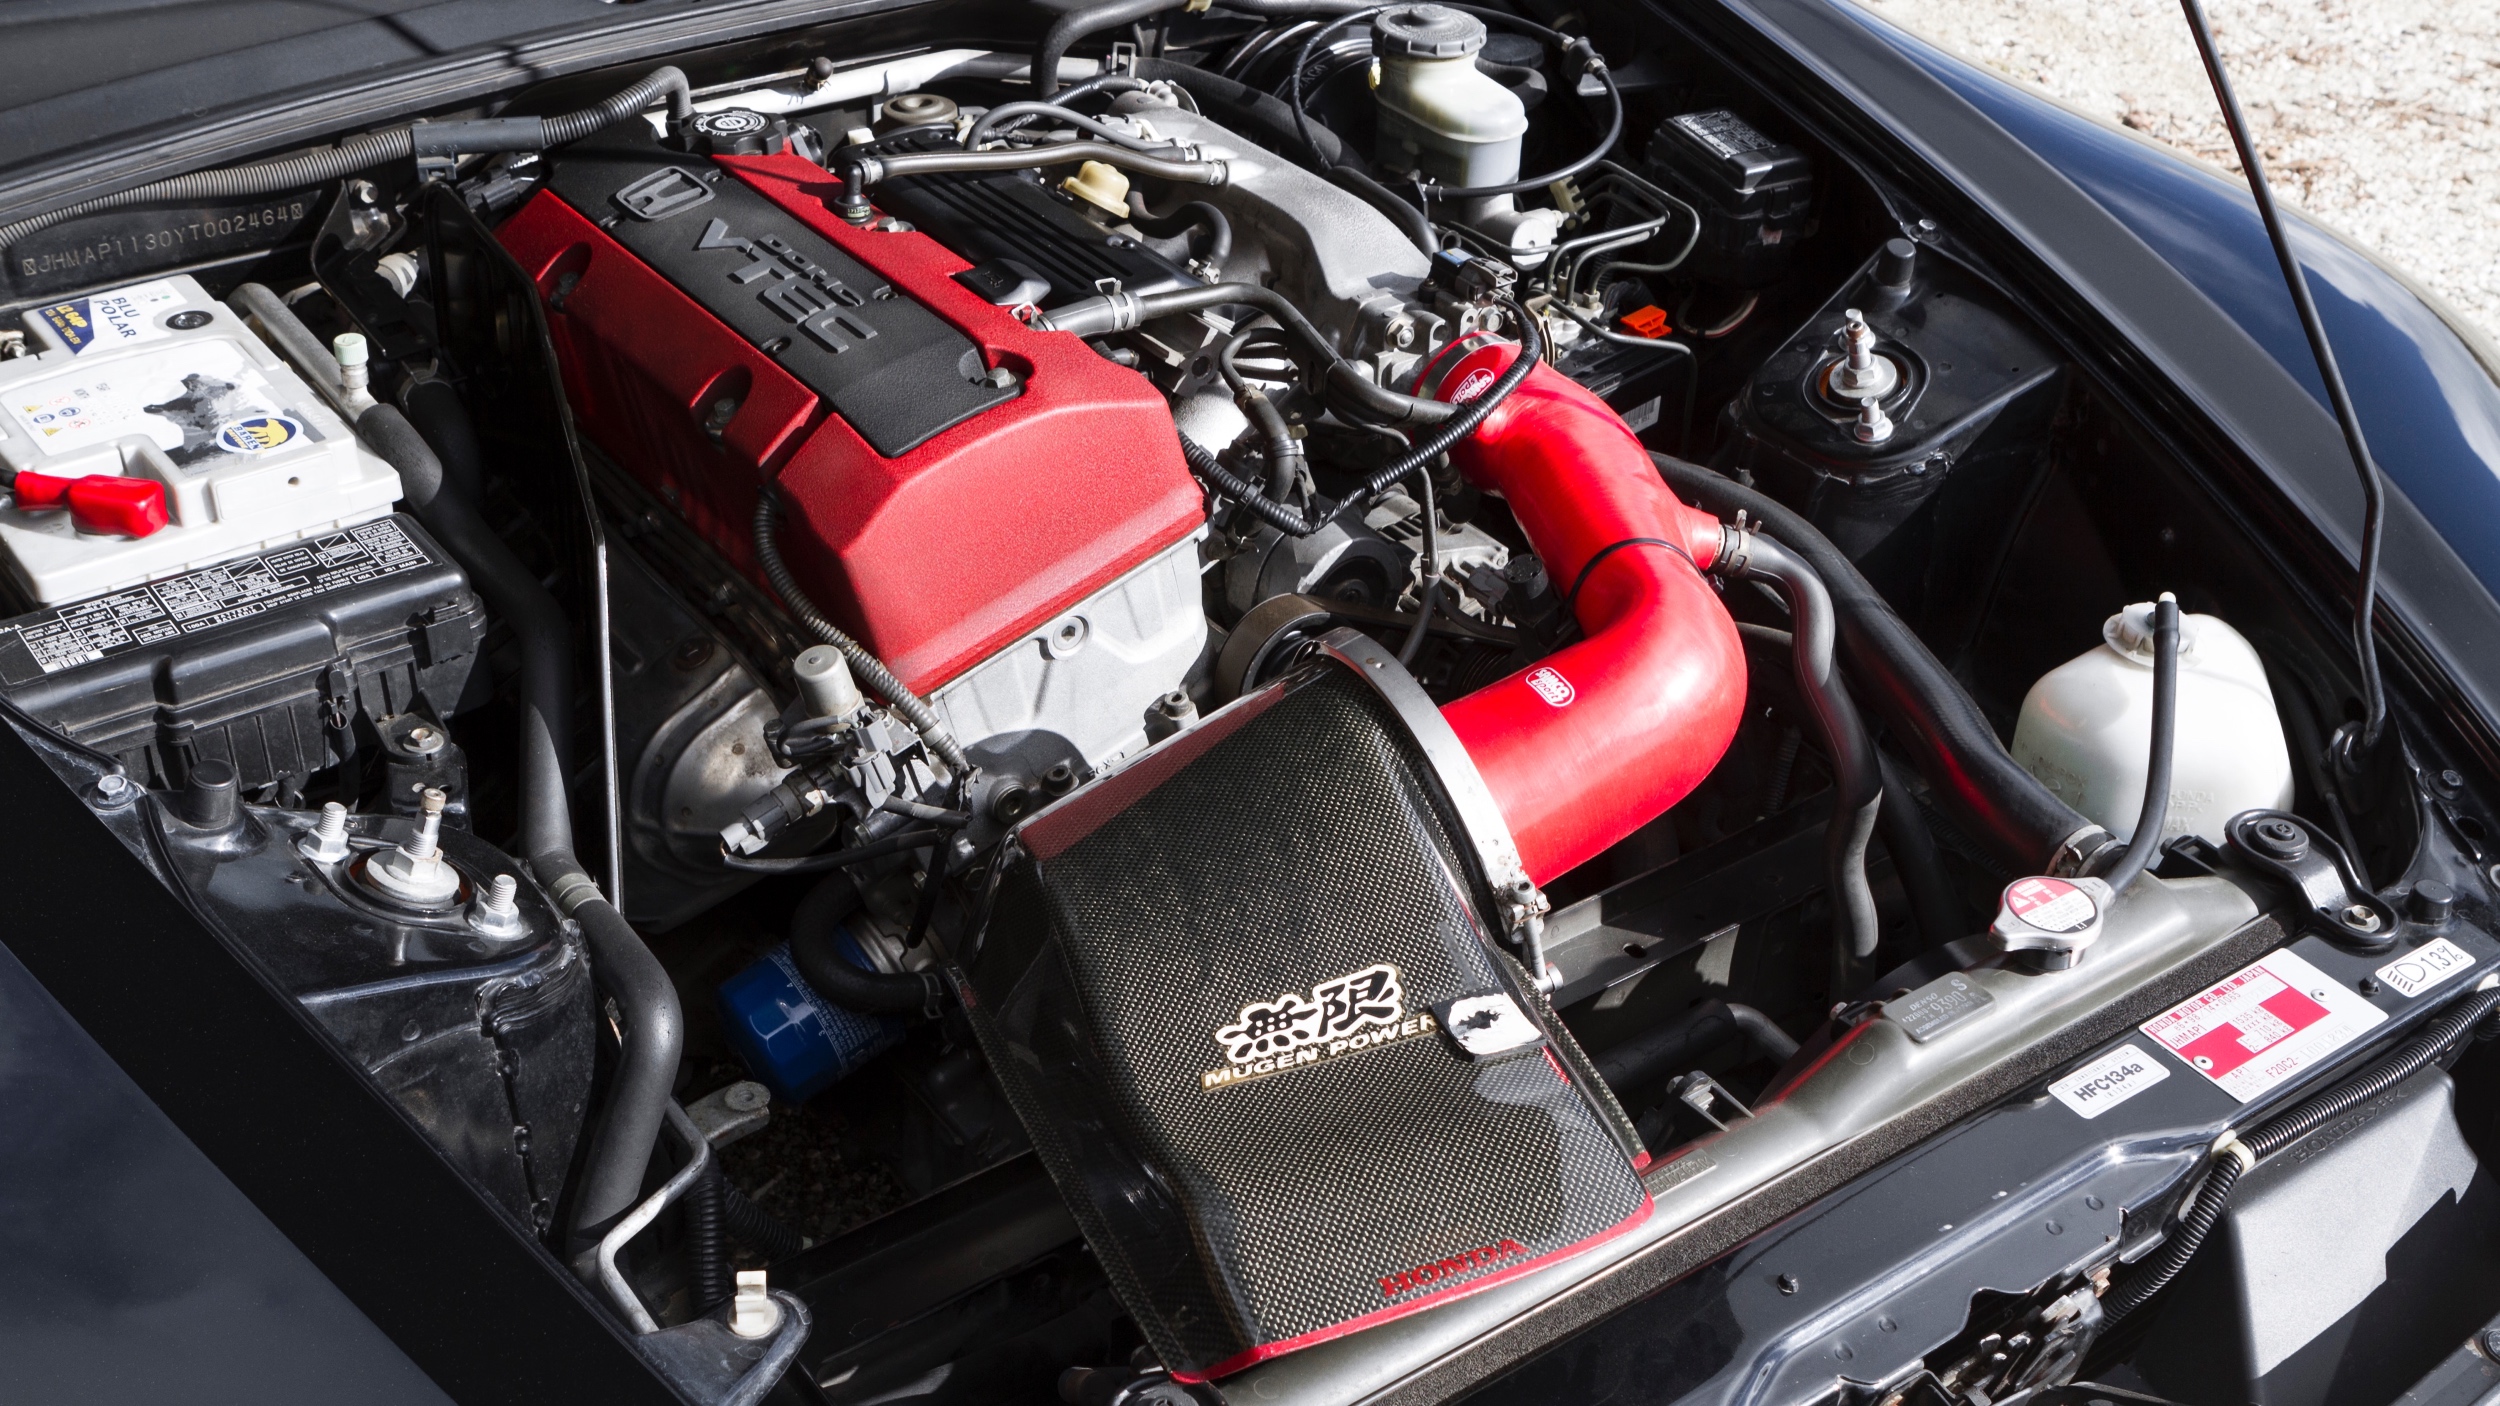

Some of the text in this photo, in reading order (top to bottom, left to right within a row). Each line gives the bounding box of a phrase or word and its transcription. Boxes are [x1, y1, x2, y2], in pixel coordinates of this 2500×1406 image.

[697, 217, 880, 355] VTEC
[755, 233, 866, 307] DOHC
[95, 300, 137, 338] POLAR
[112, 297, 140, 318] BLU
[2420, 945, 2464, 971] 1.3%
[1950, 978, 1968, 991] S
[2145, 1014, 2179, 1034] HONDA
[2173, 998, 2206, 1018] MOTOR
[2236, 965, 2266, 983] JAPAN
[1215, 965, 1403, 1063] 無限
[1909, 992, 1938, 1011] DENSO
[2230, 1011, 2255, 1026] 1535
[2252, 1023, 2273, 1037] 710
[1203, 1014, 1440, 1088] MUGEN POWER
[2167, 1023, 2208, 1048] JHMAP1
[2261, 1030, 2283, 1043] 840
[2071, 1058, 2145, 1103] HFC134a
[2229, 1065, 2252, 1080] AP1
[2289, 1113, 2374, 1164] HONDA
[1378, 1238, 1531, 1298] HONDA
